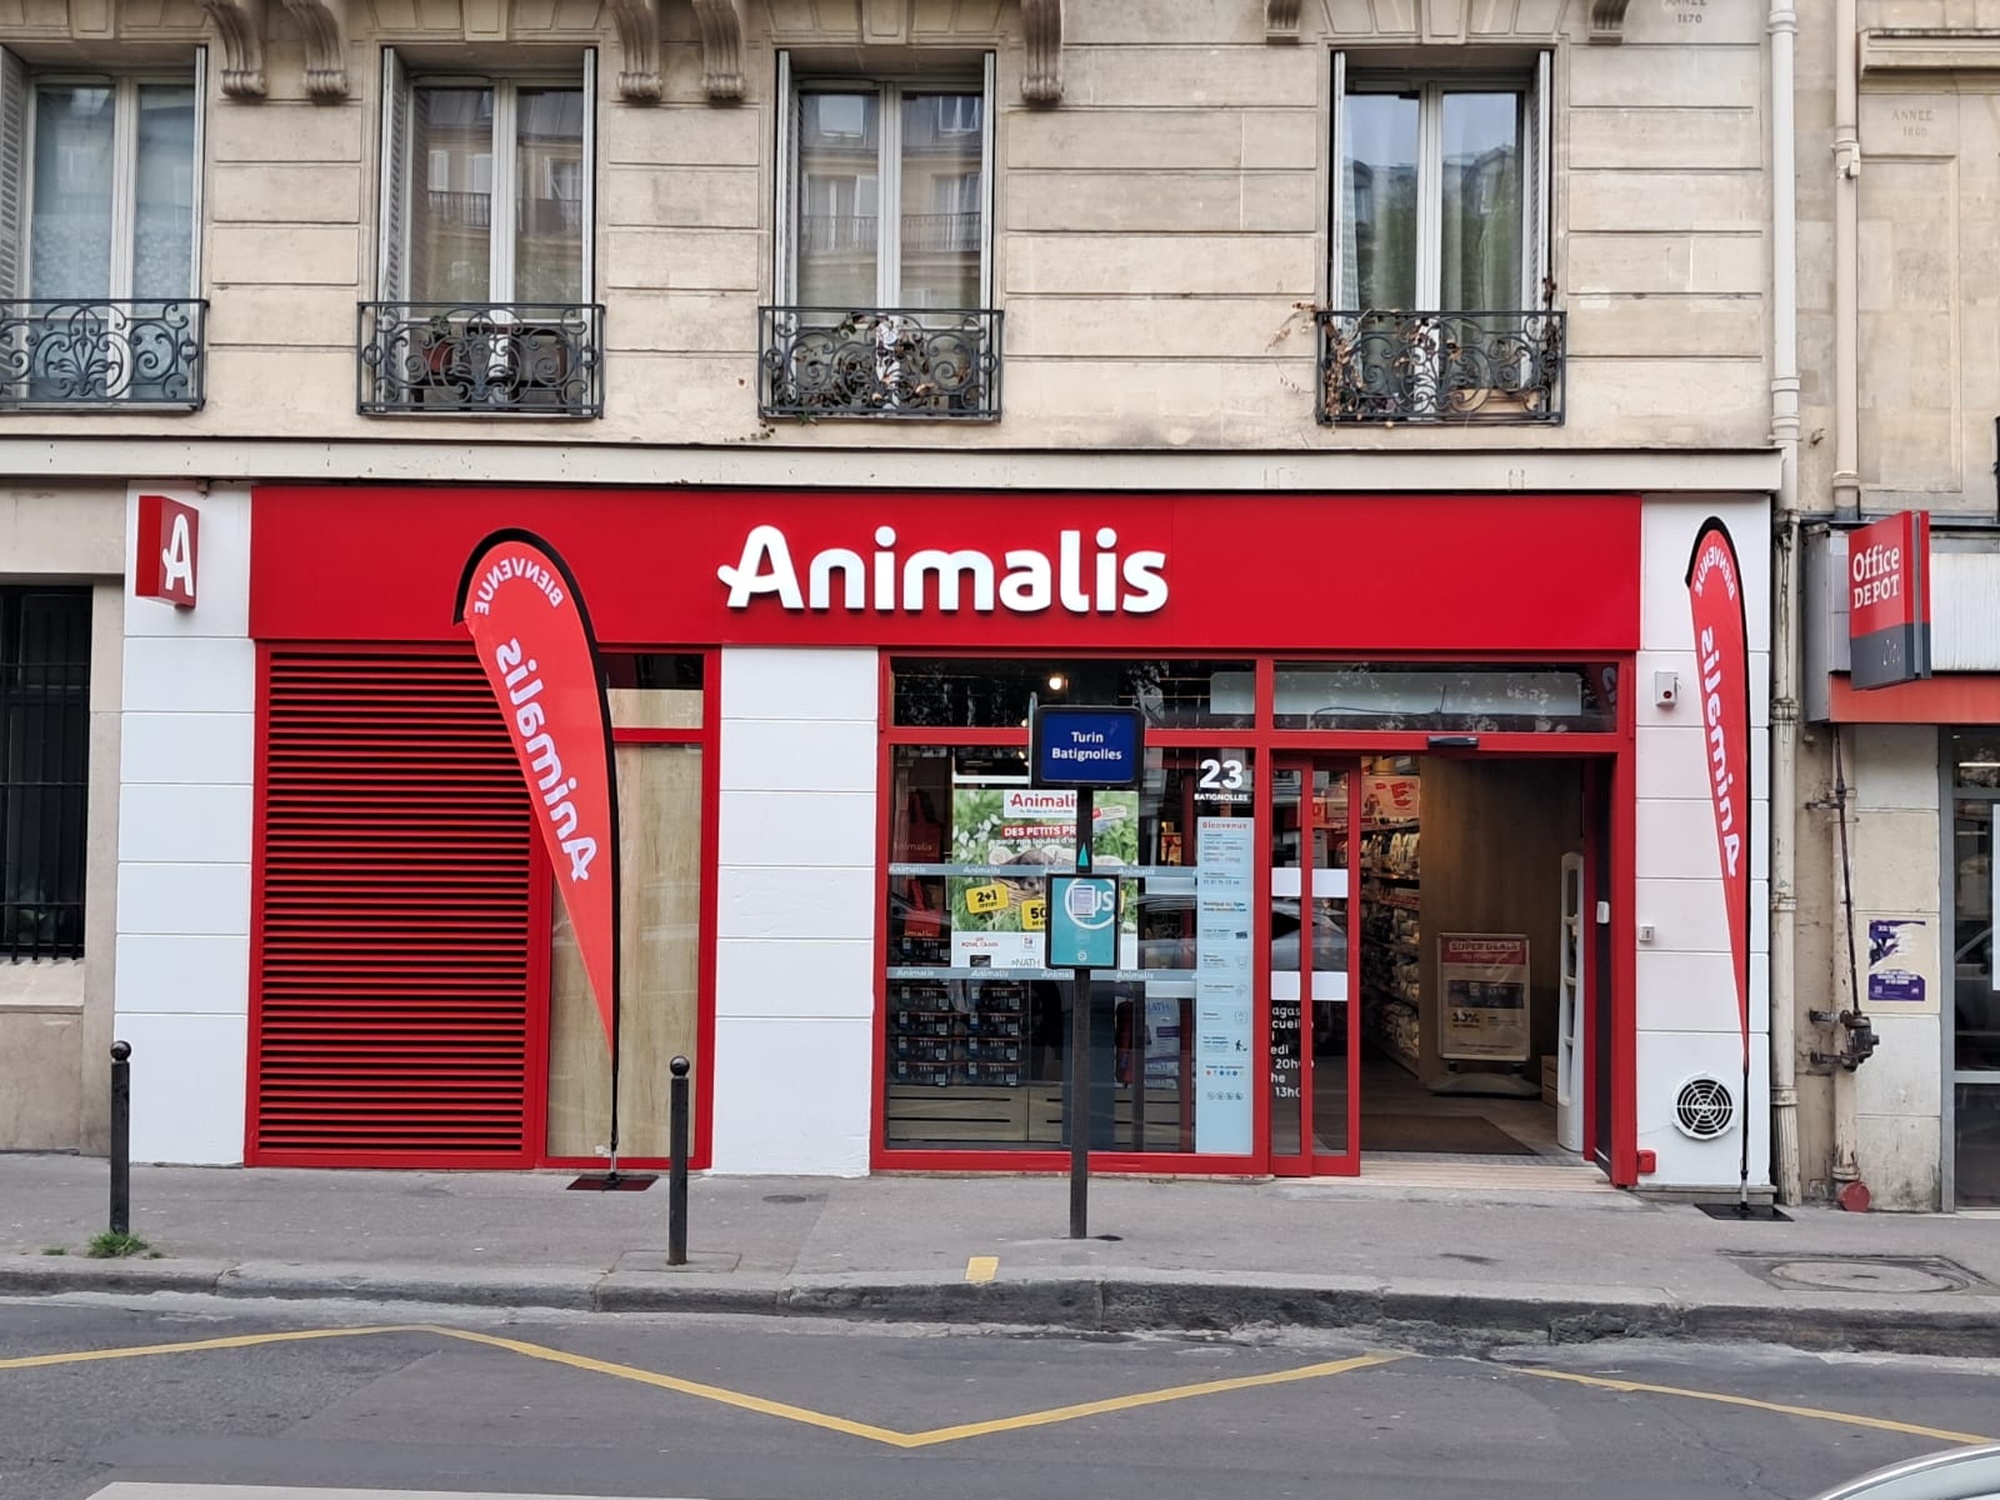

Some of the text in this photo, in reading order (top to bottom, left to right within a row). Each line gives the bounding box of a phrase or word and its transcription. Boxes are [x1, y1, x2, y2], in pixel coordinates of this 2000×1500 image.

[162, 513, 194, 596] A
[717, 525, 1169, 613] Animalis
[1852, 544, 1900, 583] Office
[1853, 573, 1901, 609] DEPOT
[1071, 731, 1104, 743] Turin
[1052, 747, 1122, 762] Batignolles
[1199, 759, 1243, 789] 23
[1010, 793, 1078, 808] Animali
[1194, 793, 1248, 801] BATIGNOLLES
[1004, 825, 1077, 837] DES PETITS PR
[976, 889, 997, 901] 2+1
